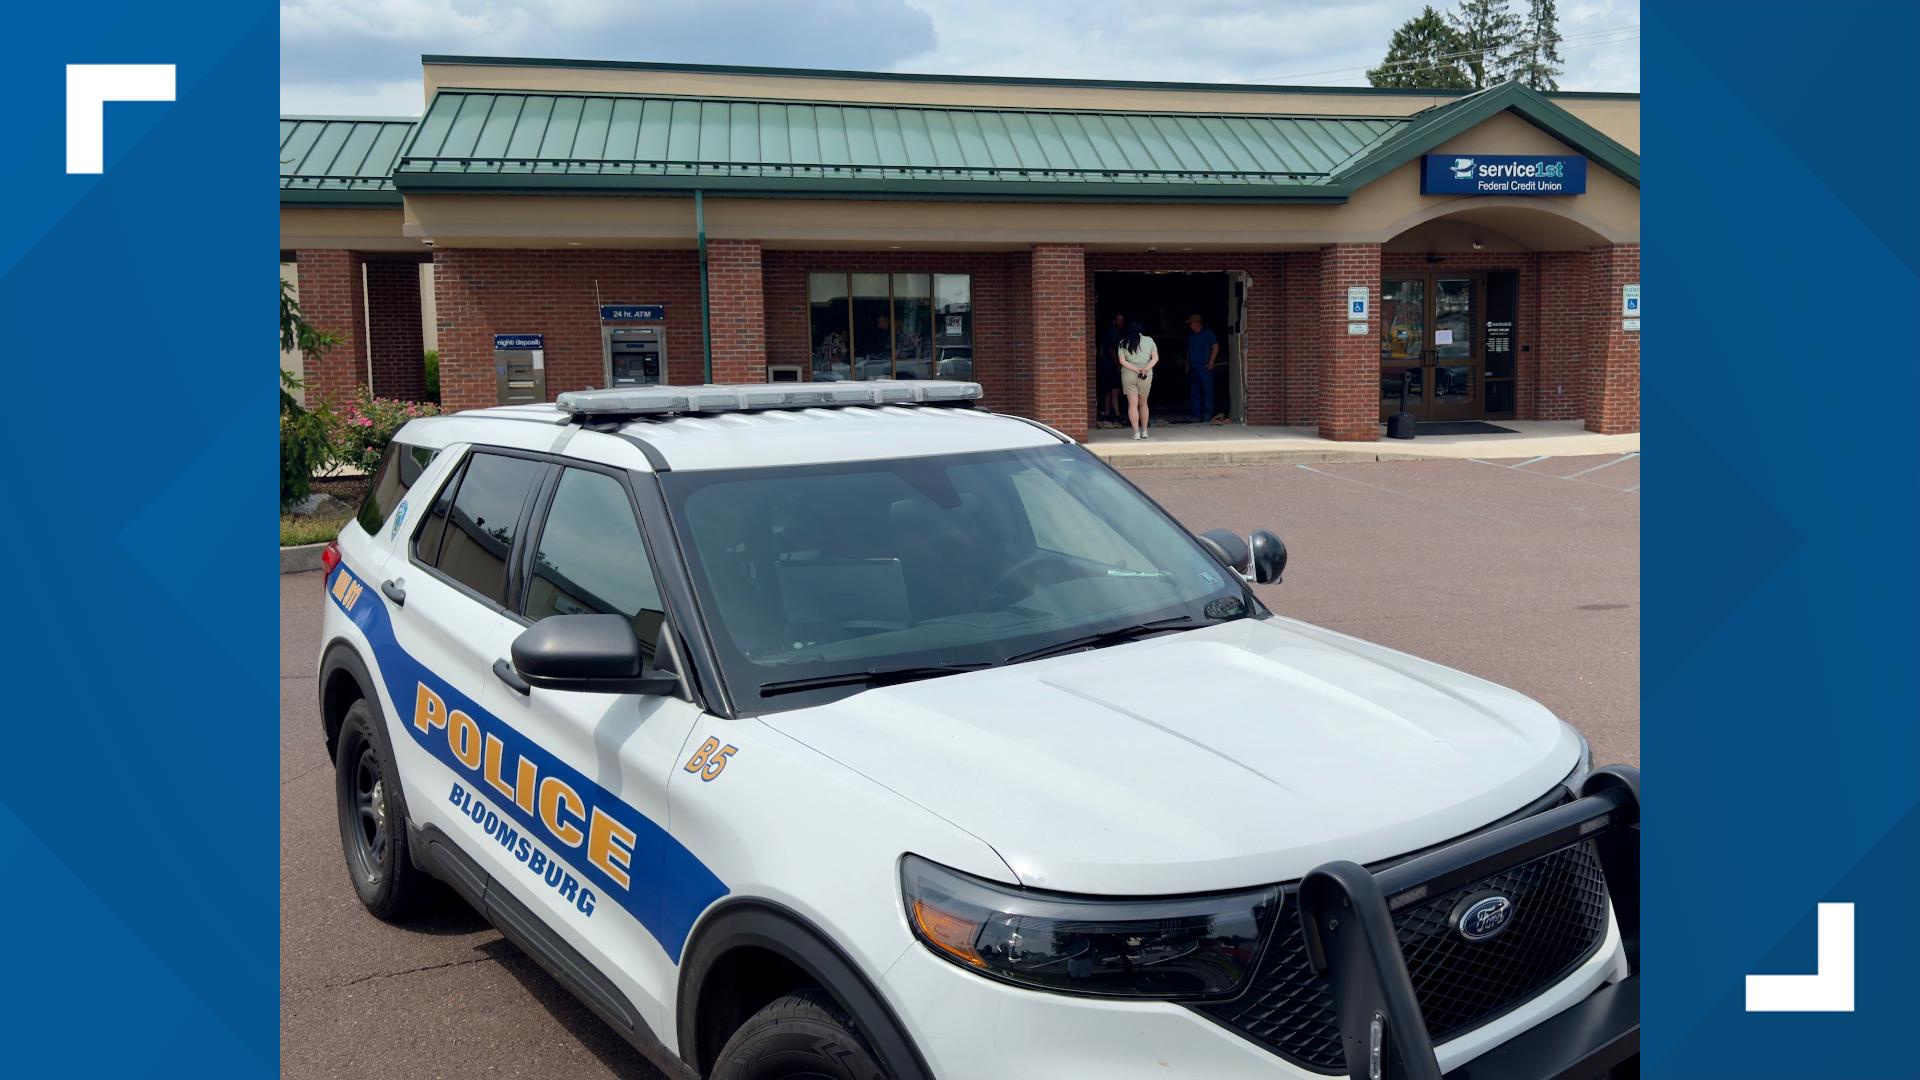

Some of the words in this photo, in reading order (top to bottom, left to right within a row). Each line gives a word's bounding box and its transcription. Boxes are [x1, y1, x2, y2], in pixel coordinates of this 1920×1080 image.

[1478, 161, 1564, 178] service1st
[1478, 180, 1509, 191] Federal
[1510, 180, 1536, 191] Credit
[1537, 181, 1562, 191] Union
[623, 310, 633, 318] hr.
[496, 339, 514, 347] night
[515, 339, 541, 347] deposit
[683, 735, 740, 783] B5
[413, 680, 637, 892] POLICE
[448, 782, 597, 918] BLOOMSBURG
[1476, 902, 1505, 933] Ford
